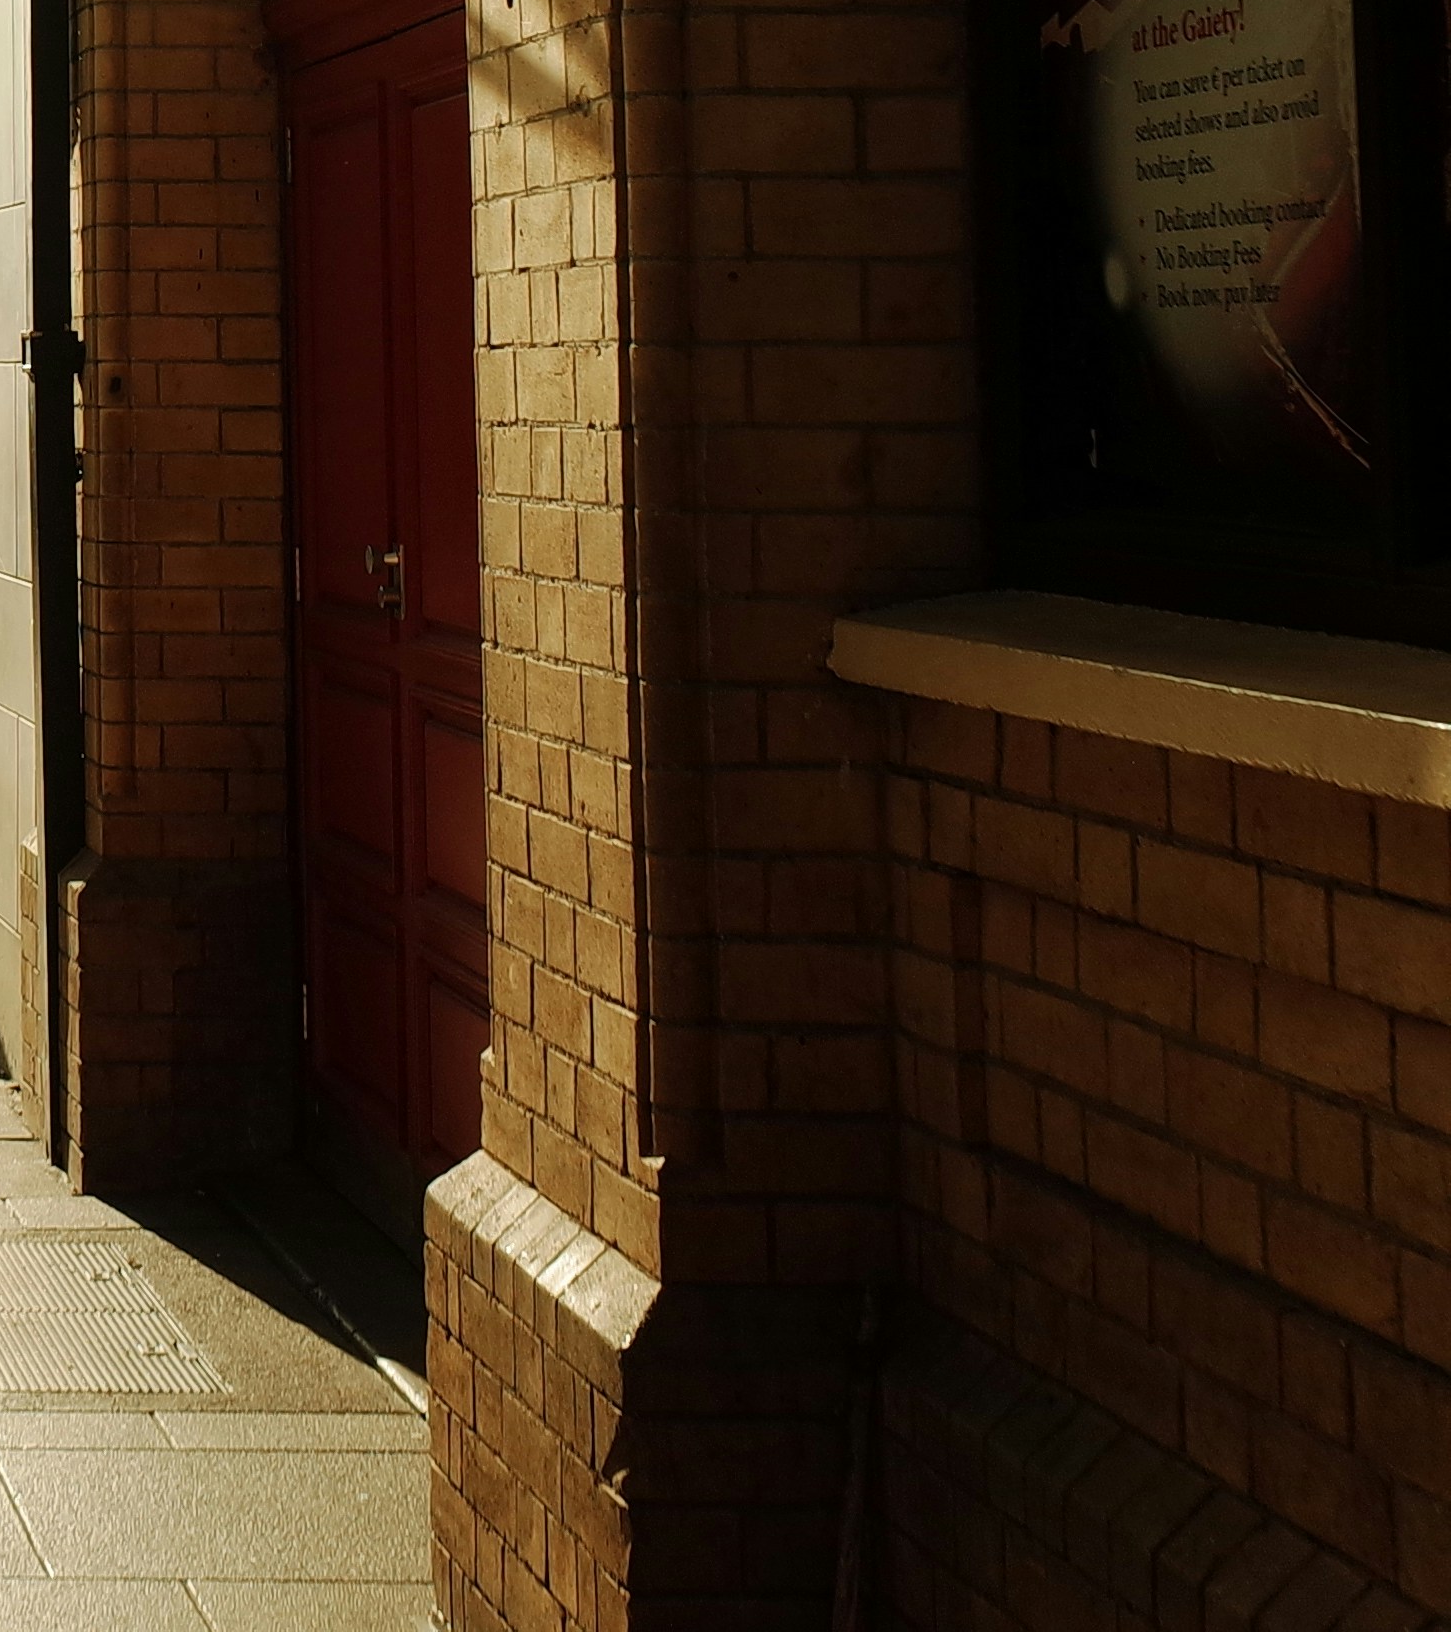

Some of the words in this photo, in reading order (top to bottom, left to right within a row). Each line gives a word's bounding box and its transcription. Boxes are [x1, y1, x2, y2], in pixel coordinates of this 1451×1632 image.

[1132, 23, 1147, 52] at
[1152, 15, 1178, 48] the
[1157, 80, 1181, 99] can
[1222, 70, 1243, 96] per
[1247, 56, 1283, 84] ticket
[1286, 58, 1305, 78] on
[1134, 113, 1181, 143] selected
[1184, 109, 1221, 136] shows
[1225, 101, 1249, 129] and
[1251, 99, 1278, 124] also
[1282, 89, 1319, 120] avoid
[1134, 156, 1185, 184] booking
[1155, 202, 1216, 233] Dedicated
[1216, 199, 1272, 232] booking
[1155, 247, 1174, 270] No
[1177, 242, 1231, 274] Booking
[1232, 240, 1261, 266] Fees
[1156, 283, 1189, 308] Book
